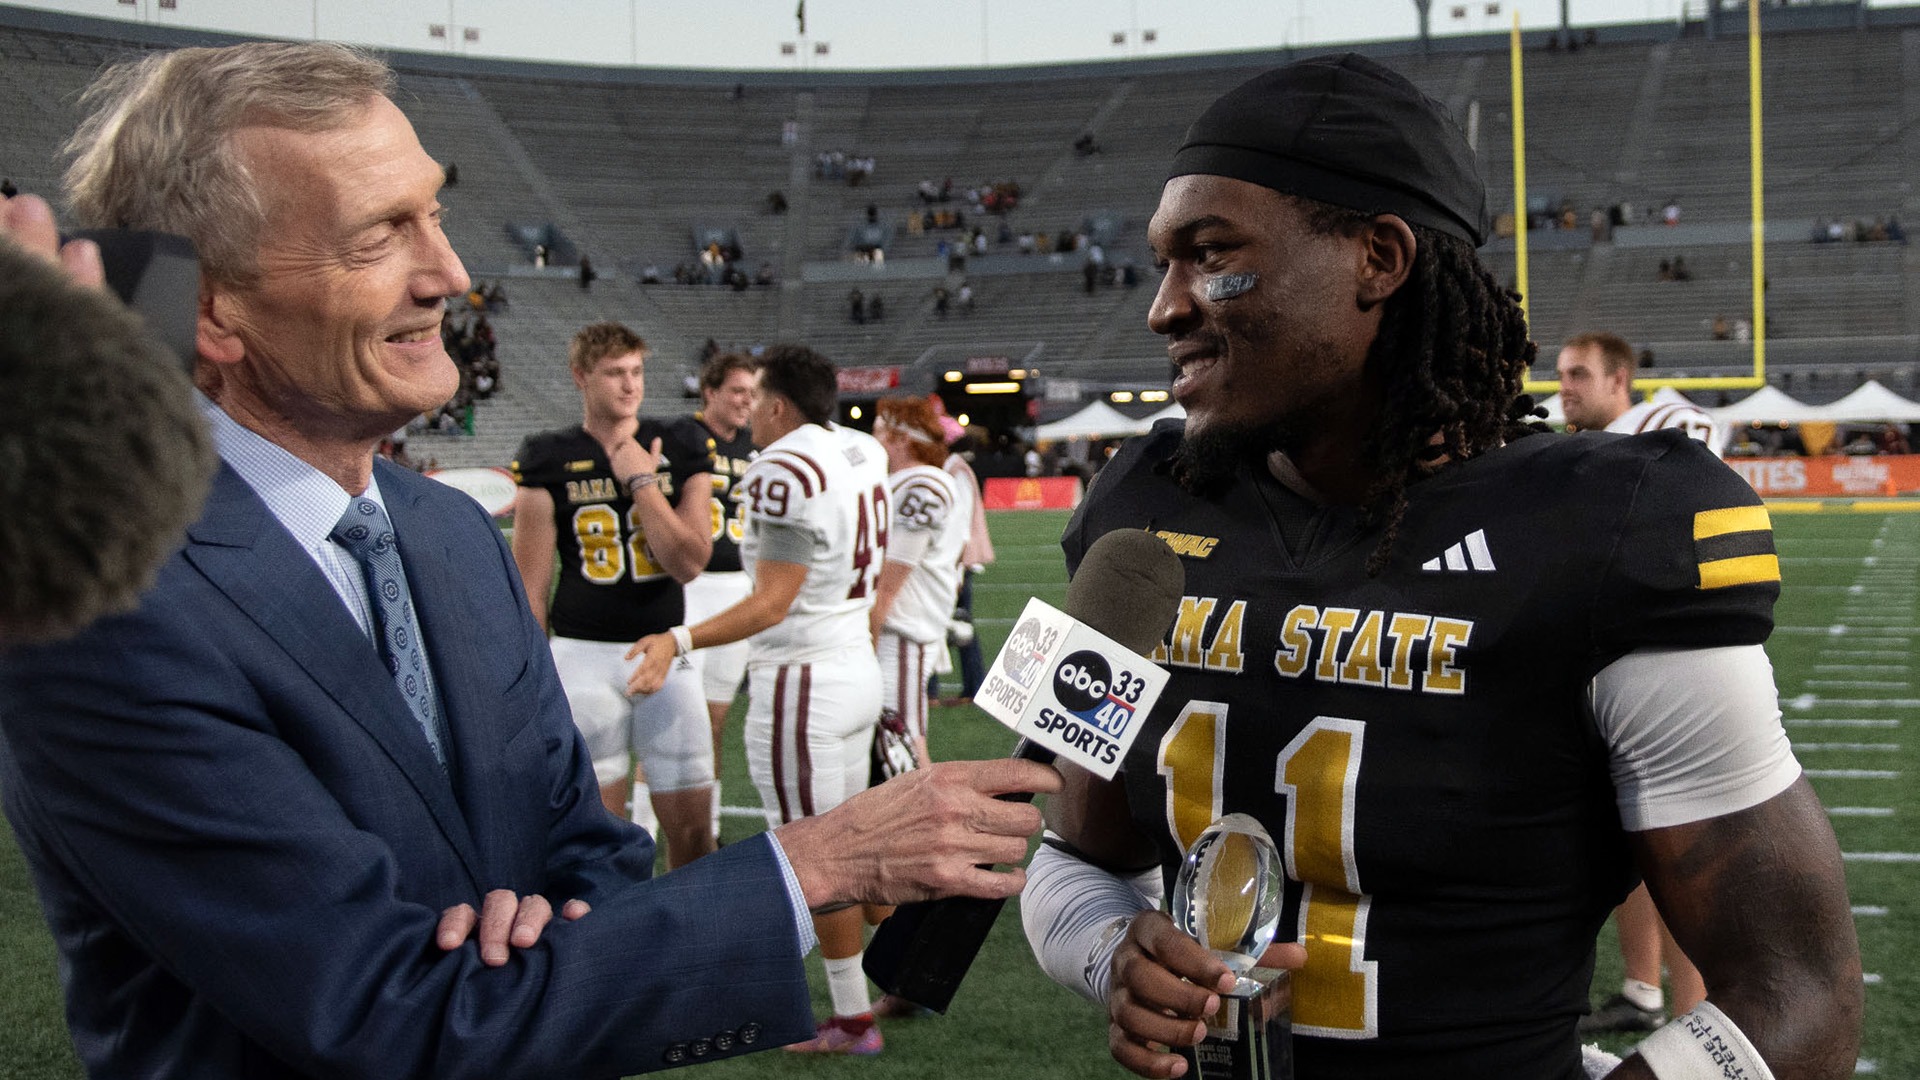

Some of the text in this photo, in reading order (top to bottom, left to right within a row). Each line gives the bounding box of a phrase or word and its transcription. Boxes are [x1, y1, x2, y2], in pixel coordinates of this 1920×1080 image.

[566, 478, 618, 503] BAMA
[748, 474, 789, 518] 49
[900, 493, 940, 526] 65
[847, 483, 888, 599] 49
[1009, 626, 1059, 659] abc 33
[1149, 596, 1475, 694] MA STATE
[1019, 658, 1042, 689] 40
[1059, 663, 1146, 704] abc 33
[984, 674, 1028, 715] SPORTS
[1034, 707, 1121, 764] SPORTS
[1094, 704, 1129, 737] 40
[1686, 1021, 1737, 1080] ADE IN
[1693, 1015, 1749, 1080] TENTS
